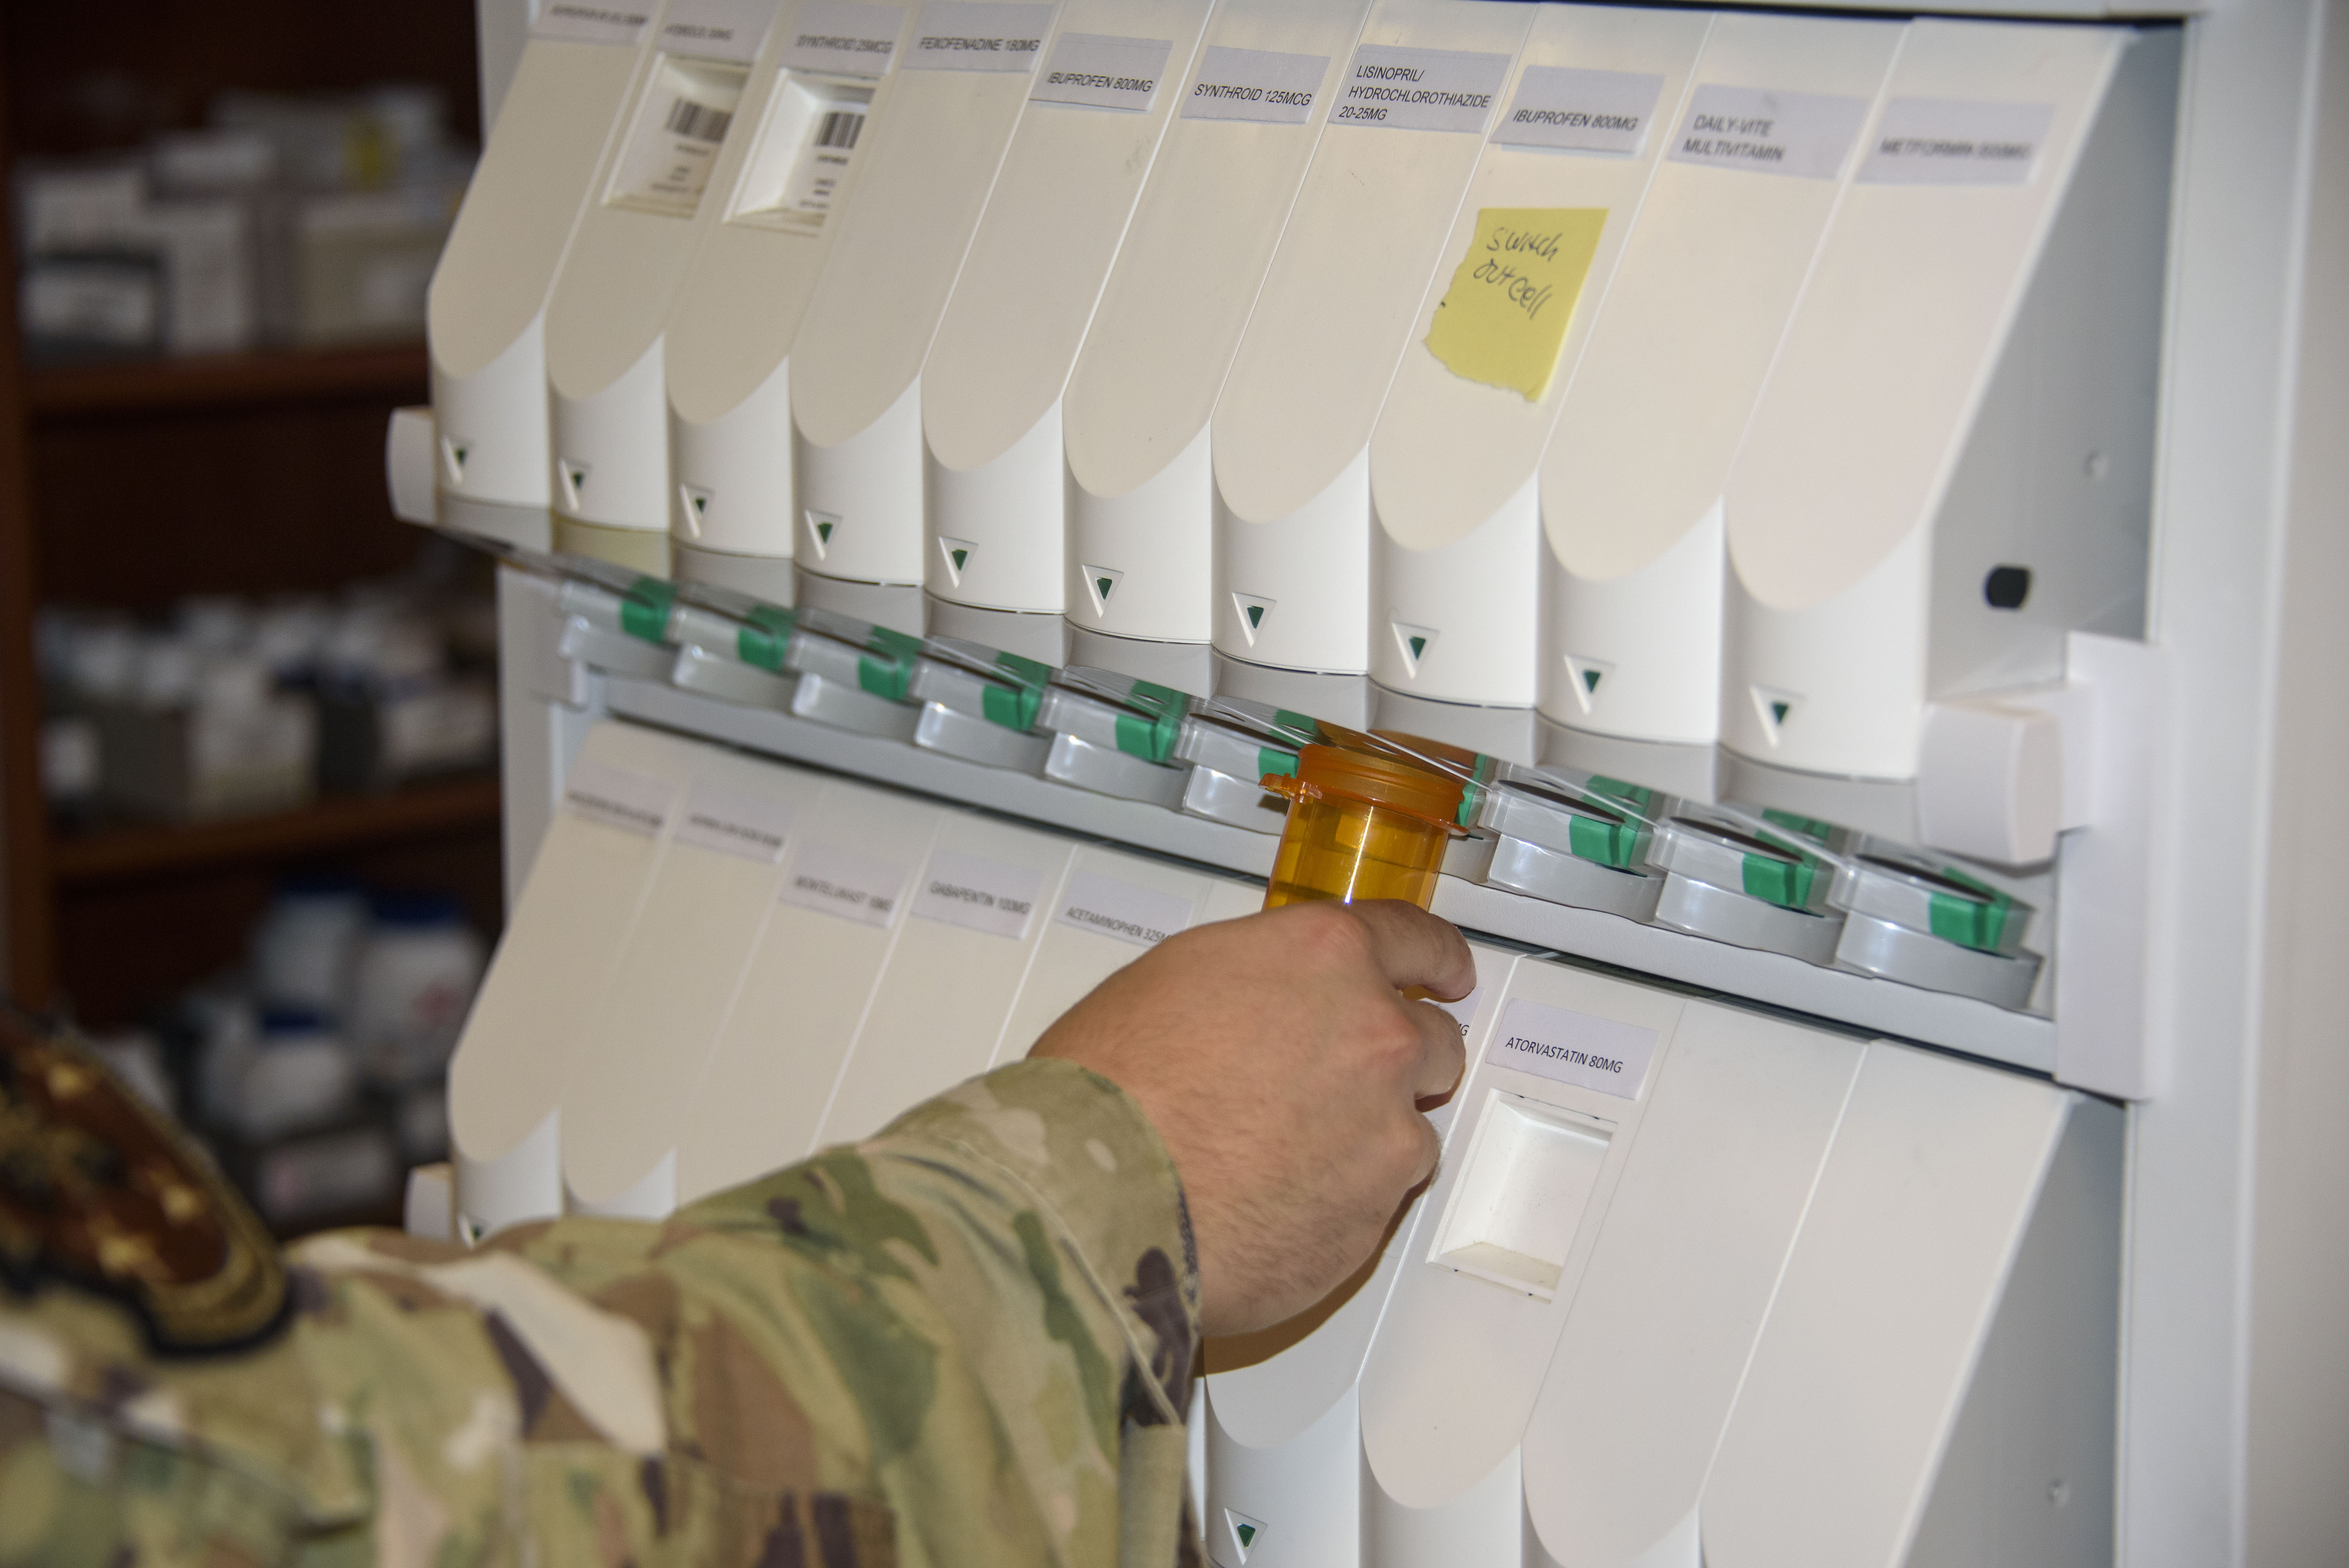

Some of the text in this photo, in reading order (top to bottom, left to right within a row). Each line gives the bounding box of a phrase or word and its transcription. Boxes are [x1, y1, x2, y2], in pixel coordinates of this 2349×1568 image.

[918, 36, 1002, 51] FEXOFENADINE
[1048, 72, 1153, 92] IBUPROFEN 800MG
[1356, 65, 1424, 82] LISINOPRIL/
[1194, 84, 1312, 106] SYNTHROID 125MCG
[1348, 86, 1491, 108] HYDROCHLOROTHIAZIDE
[1338, 106, 1388, 120] 20-25MG
[1512, 109, 1638, 131] IBUPROFEN 800MG
[1693, 114, 1774, 137] DAILY-VITE
[1682, 138, 1785, 161] MULTIVITAMIN
[929, 881, 994, 906] GABAPENTIN
[1065, 907, 1143, 937] ACETAMINOPHEN
[1506, 1037, 1623, 1073] ATORVASTATIN 80MG
